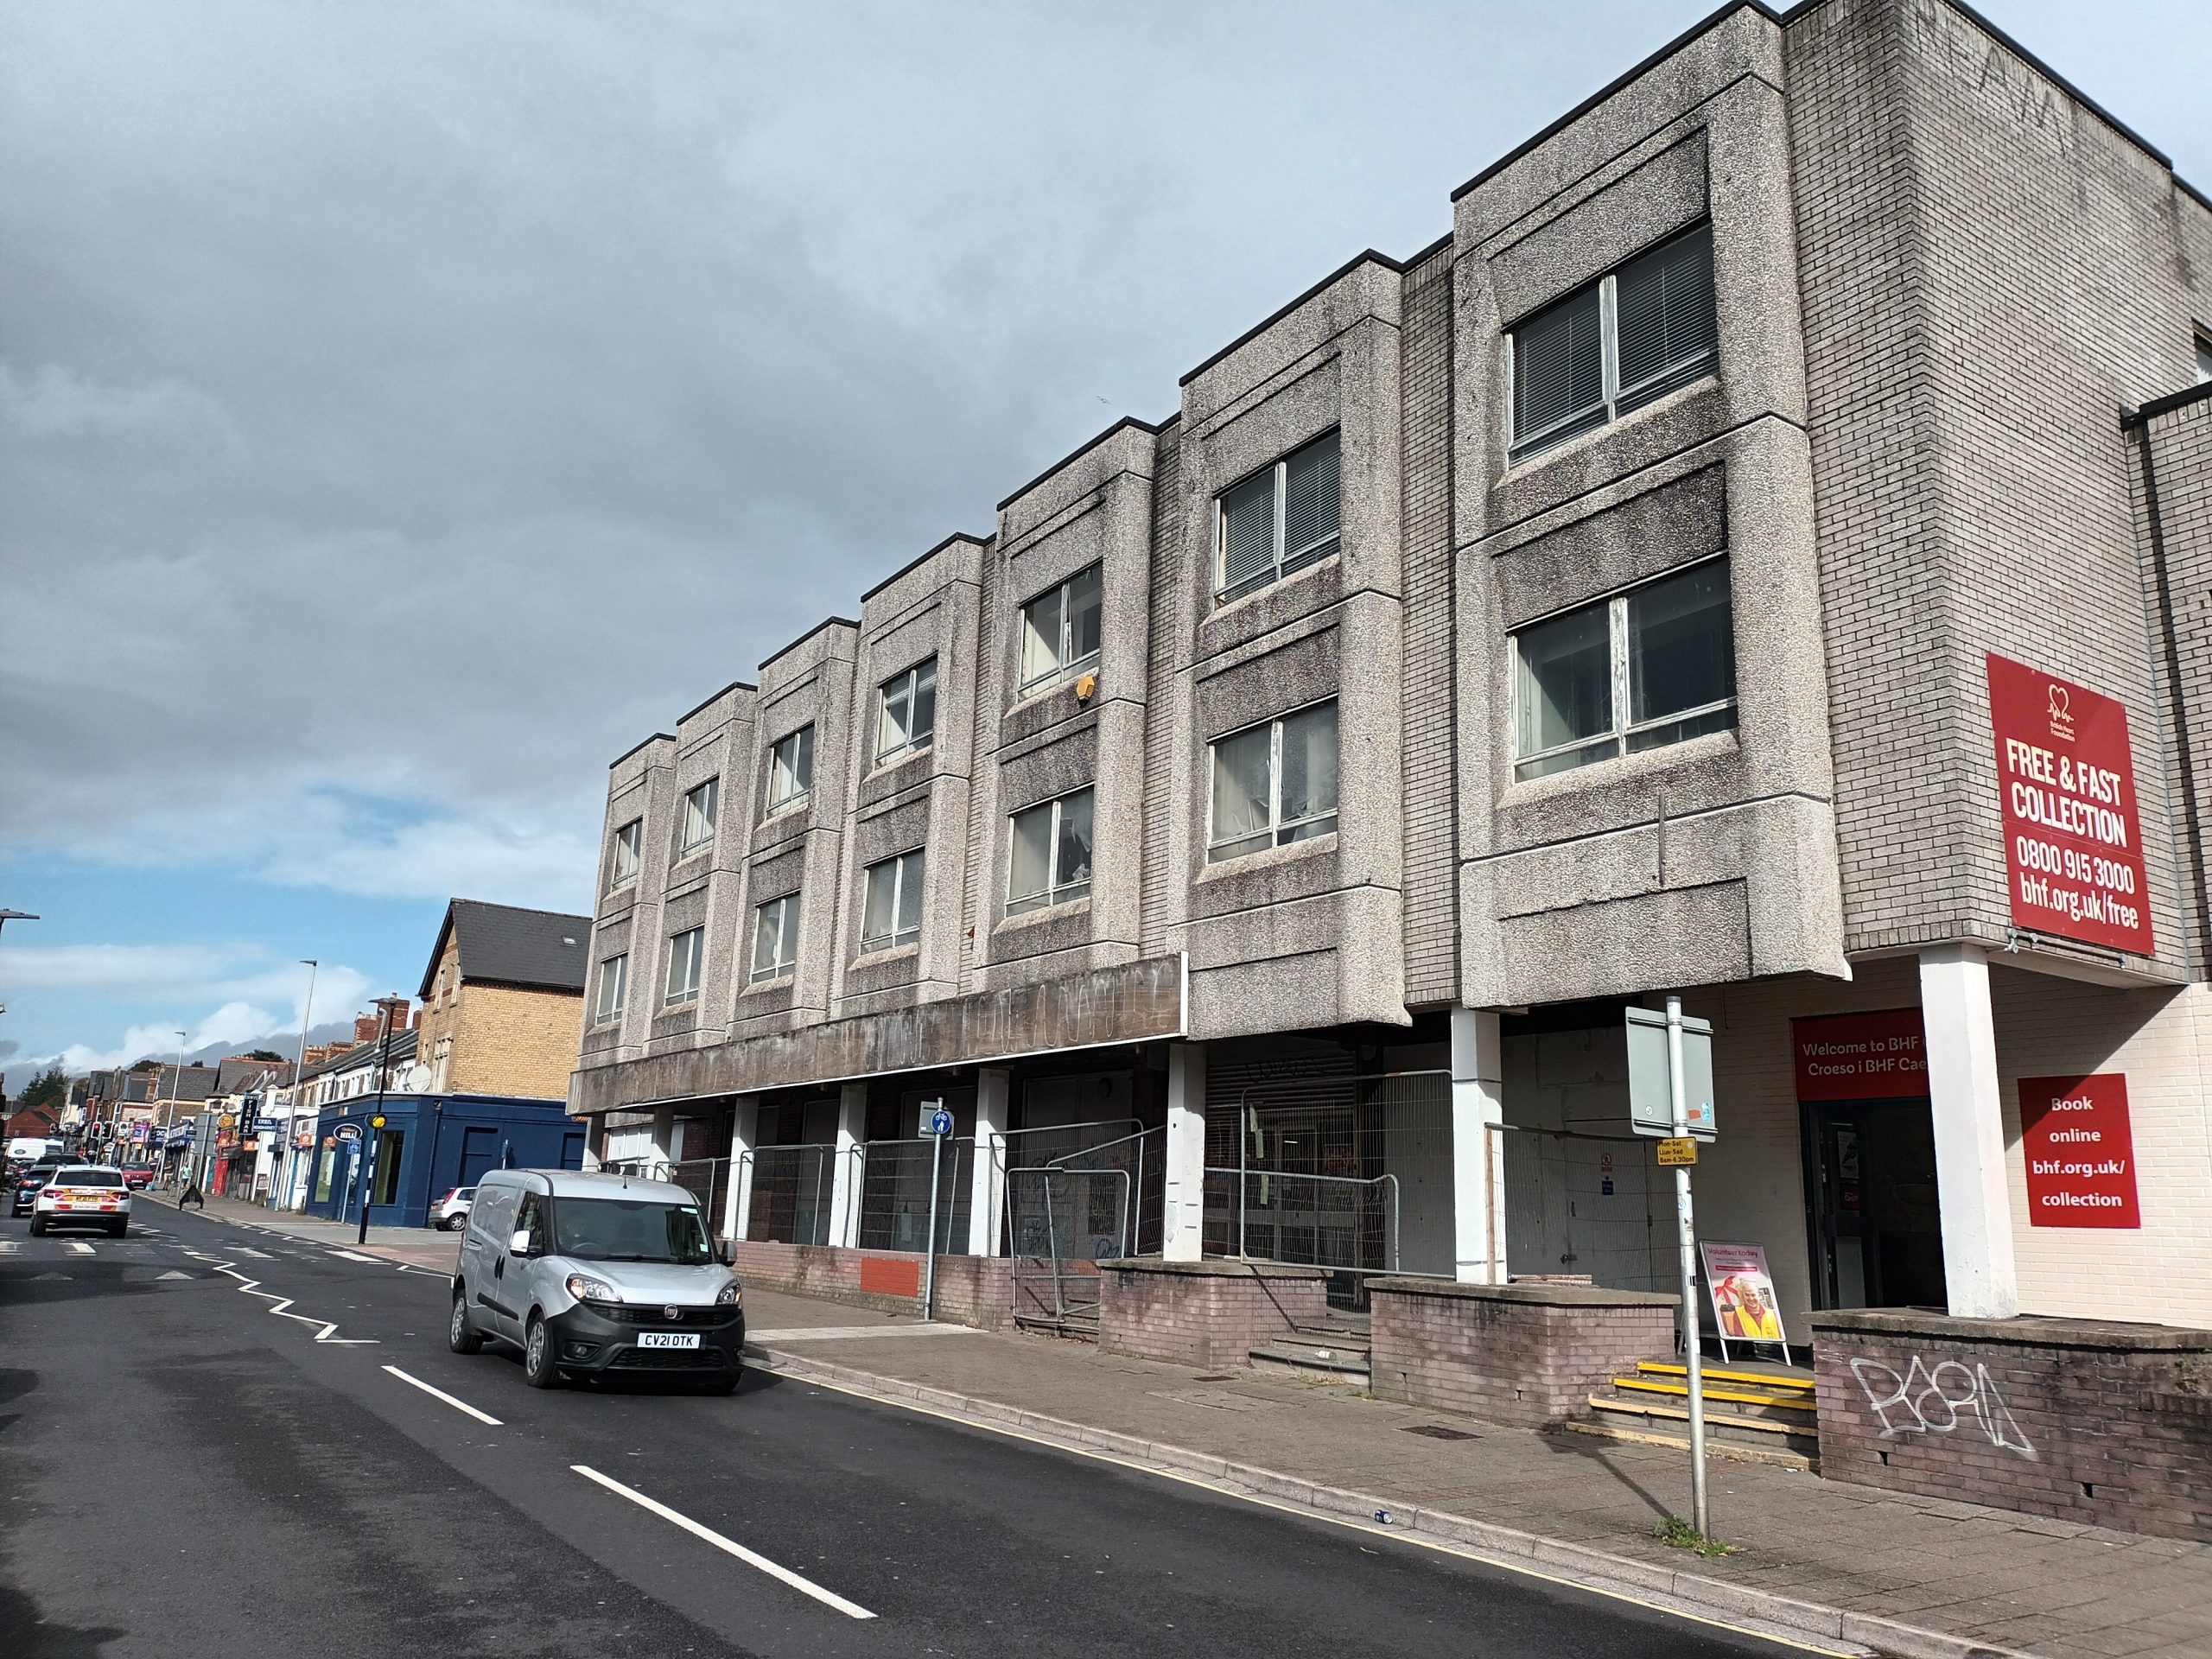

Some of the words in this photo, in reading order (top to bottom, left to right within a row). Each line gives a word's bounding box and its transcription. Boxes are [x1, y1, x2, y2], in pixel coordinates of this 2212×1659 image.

[2005, 737, 2057, 786] FREE
[2059, 755, 2077, 793] &
[2076, 760, 2121, 806] FAST
[2011, 781, 2127, 849] COLLECTION
[2016, 836, 2063, 876] 0800
[2063, 849, 2092, 884] 915
[2093, 856, 2135, 895] 3000
[2019, 872, 2139, 930] bhf.org.uk/free
[1802, 1042, 1867, 1057] Welcome
[1870, 1040, 1885, 1052] to
[1888, 1036, 1919, 1052] BHF
[1808, 1063, 1855, 1077] Croeso
[1858, 1061, 1862, 1073] i
[1866, 1058, 1896, 1073] BHF
[2050, 1096, 2094, 1111] Book
[2050, 1128, 2101, 1142] online
[2032, 1160, 2126, 1178] bhf.org.uk/
[2042, 1192, 2123, 1207] collection
[1707, 1247, 1737, 1256] Volunteer
[1738, 1249, 1758, 1258] today
[645, 1335, 670, 1345] CV21
[672, 1336, 694, 1346] OTK
